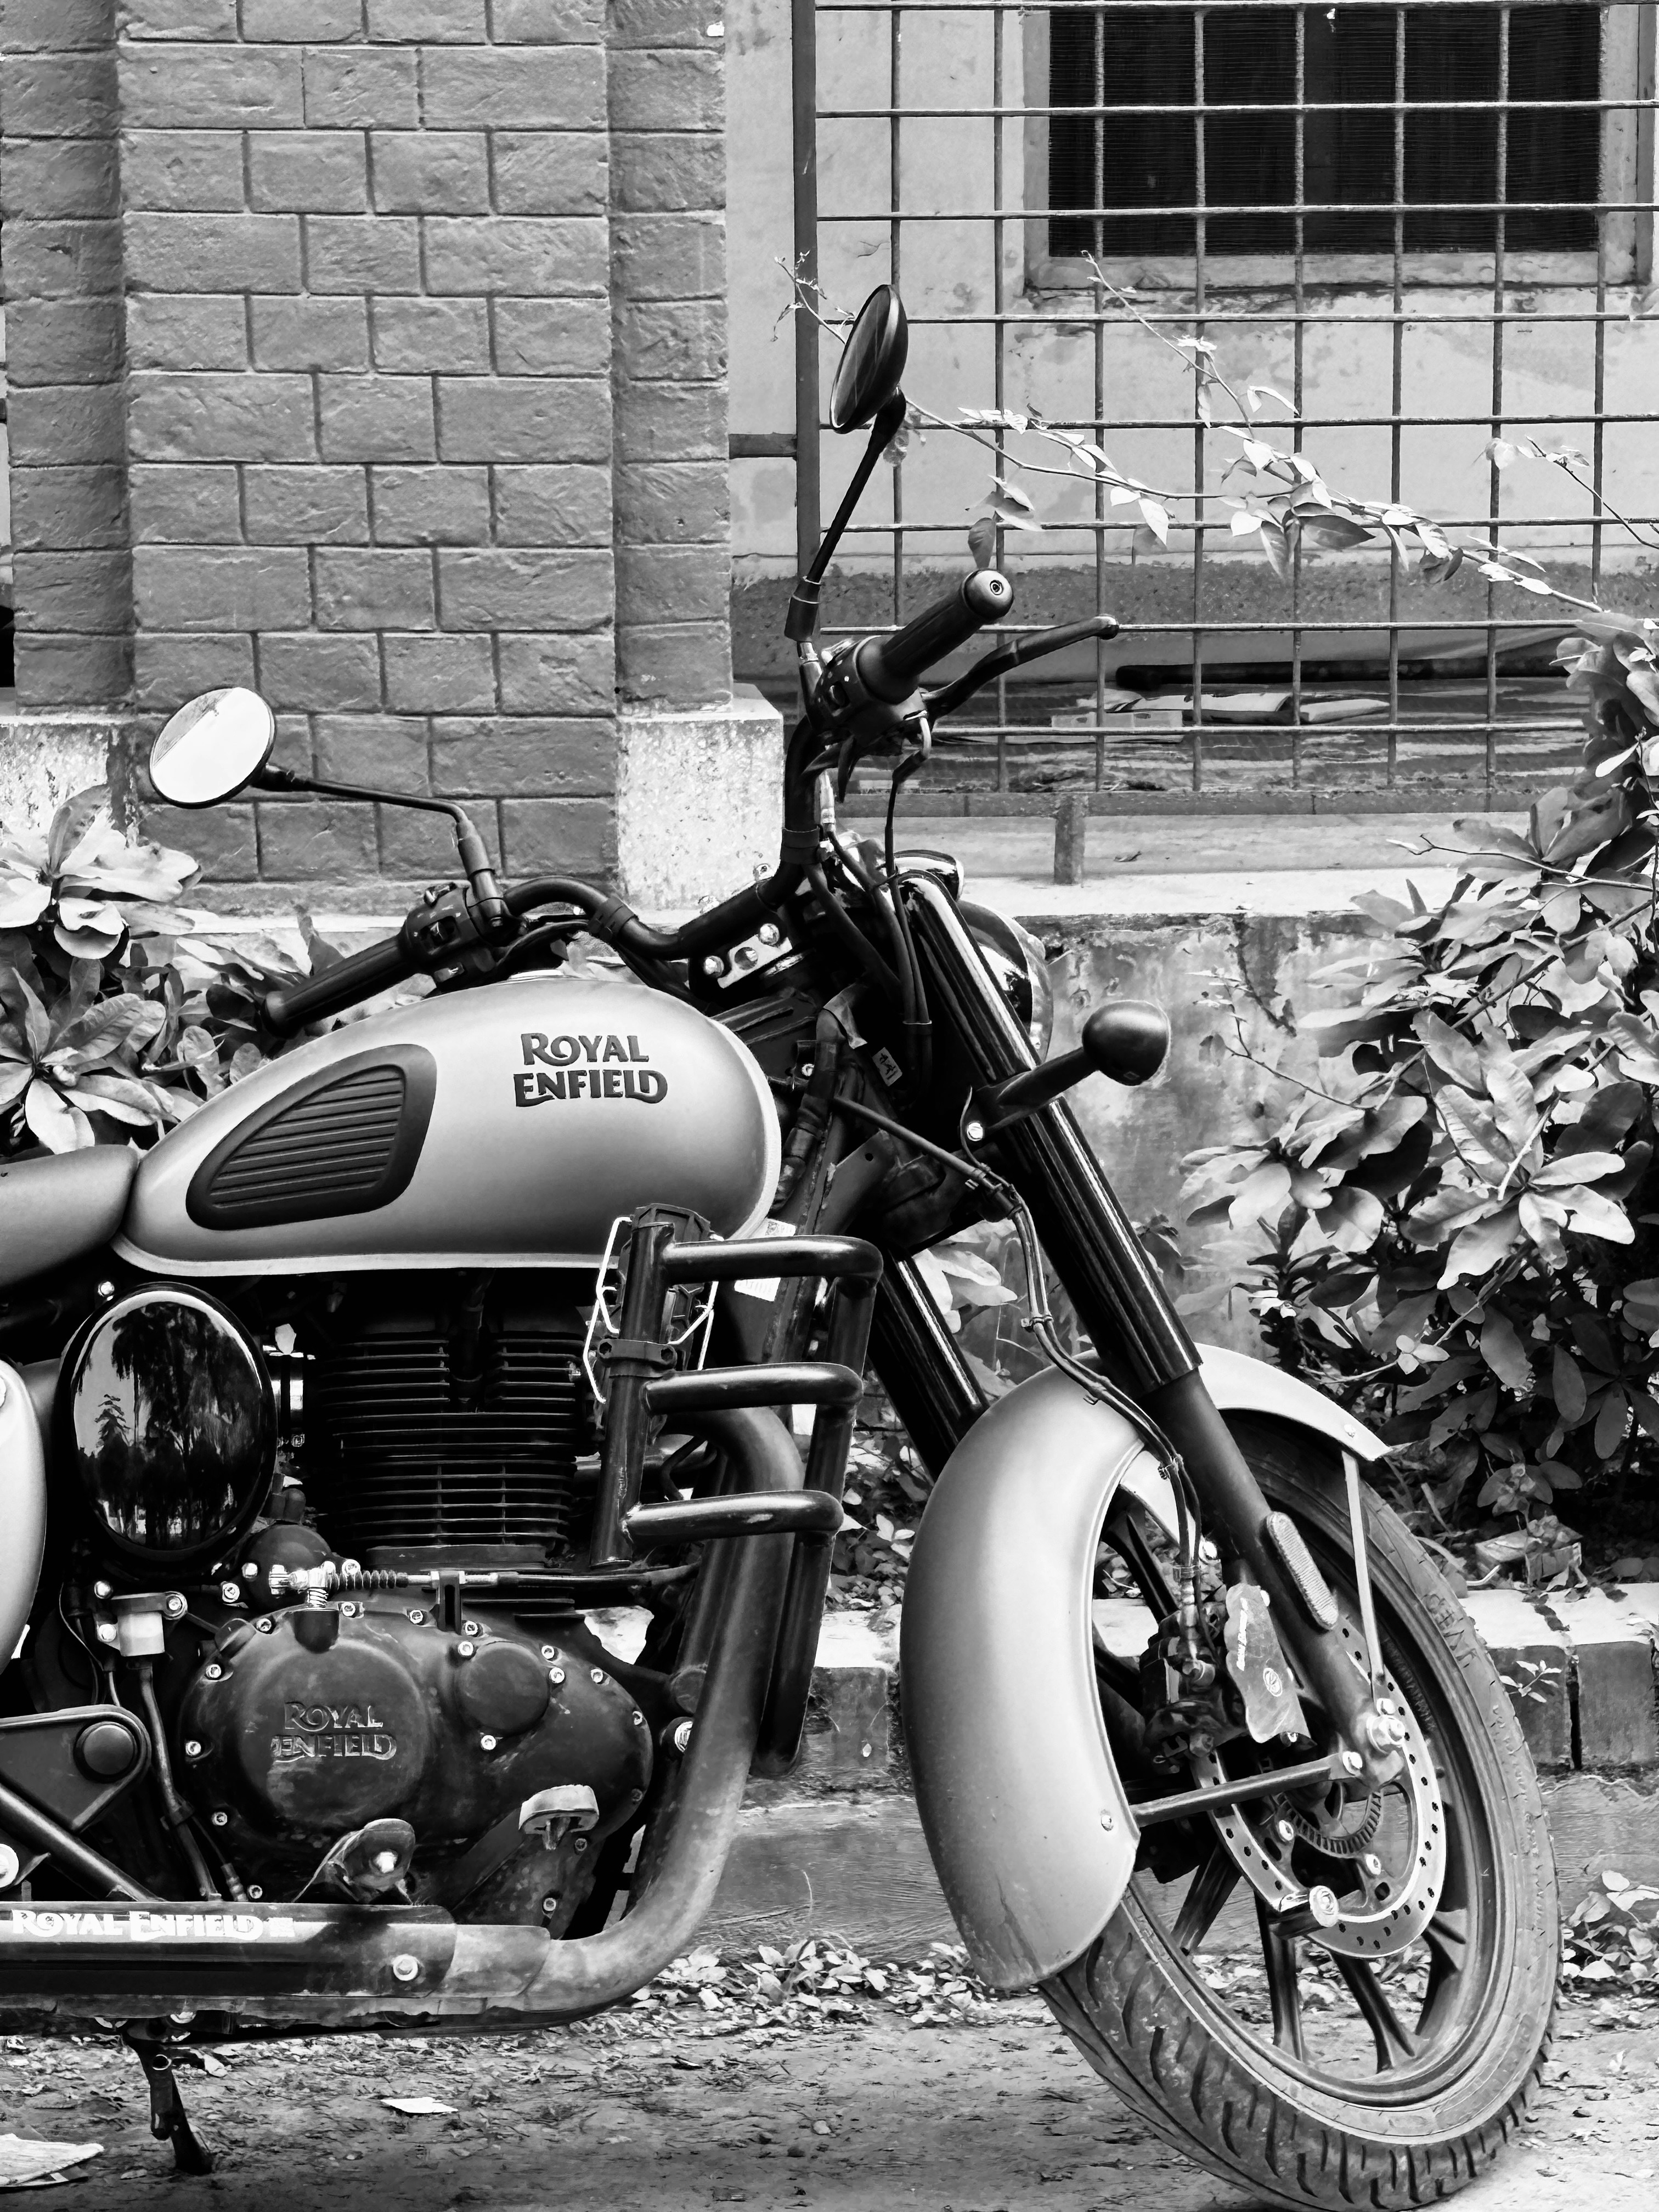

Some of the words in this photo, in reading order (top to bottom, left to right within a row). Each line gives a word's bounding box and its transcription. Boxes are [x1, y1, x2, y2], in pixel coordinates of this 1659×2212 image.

[521, 1032, 649, 1066] ROYAL
[514, 1069, 668, 1107] ENFIELD
[284, 1701, 383, 1731] ROYAL
[271, 1734, 397, 1762] ENFIELD
[12, 1909, 123, 1937] ROYAL
[129, 1911, 263, 1940] ENFIELD
